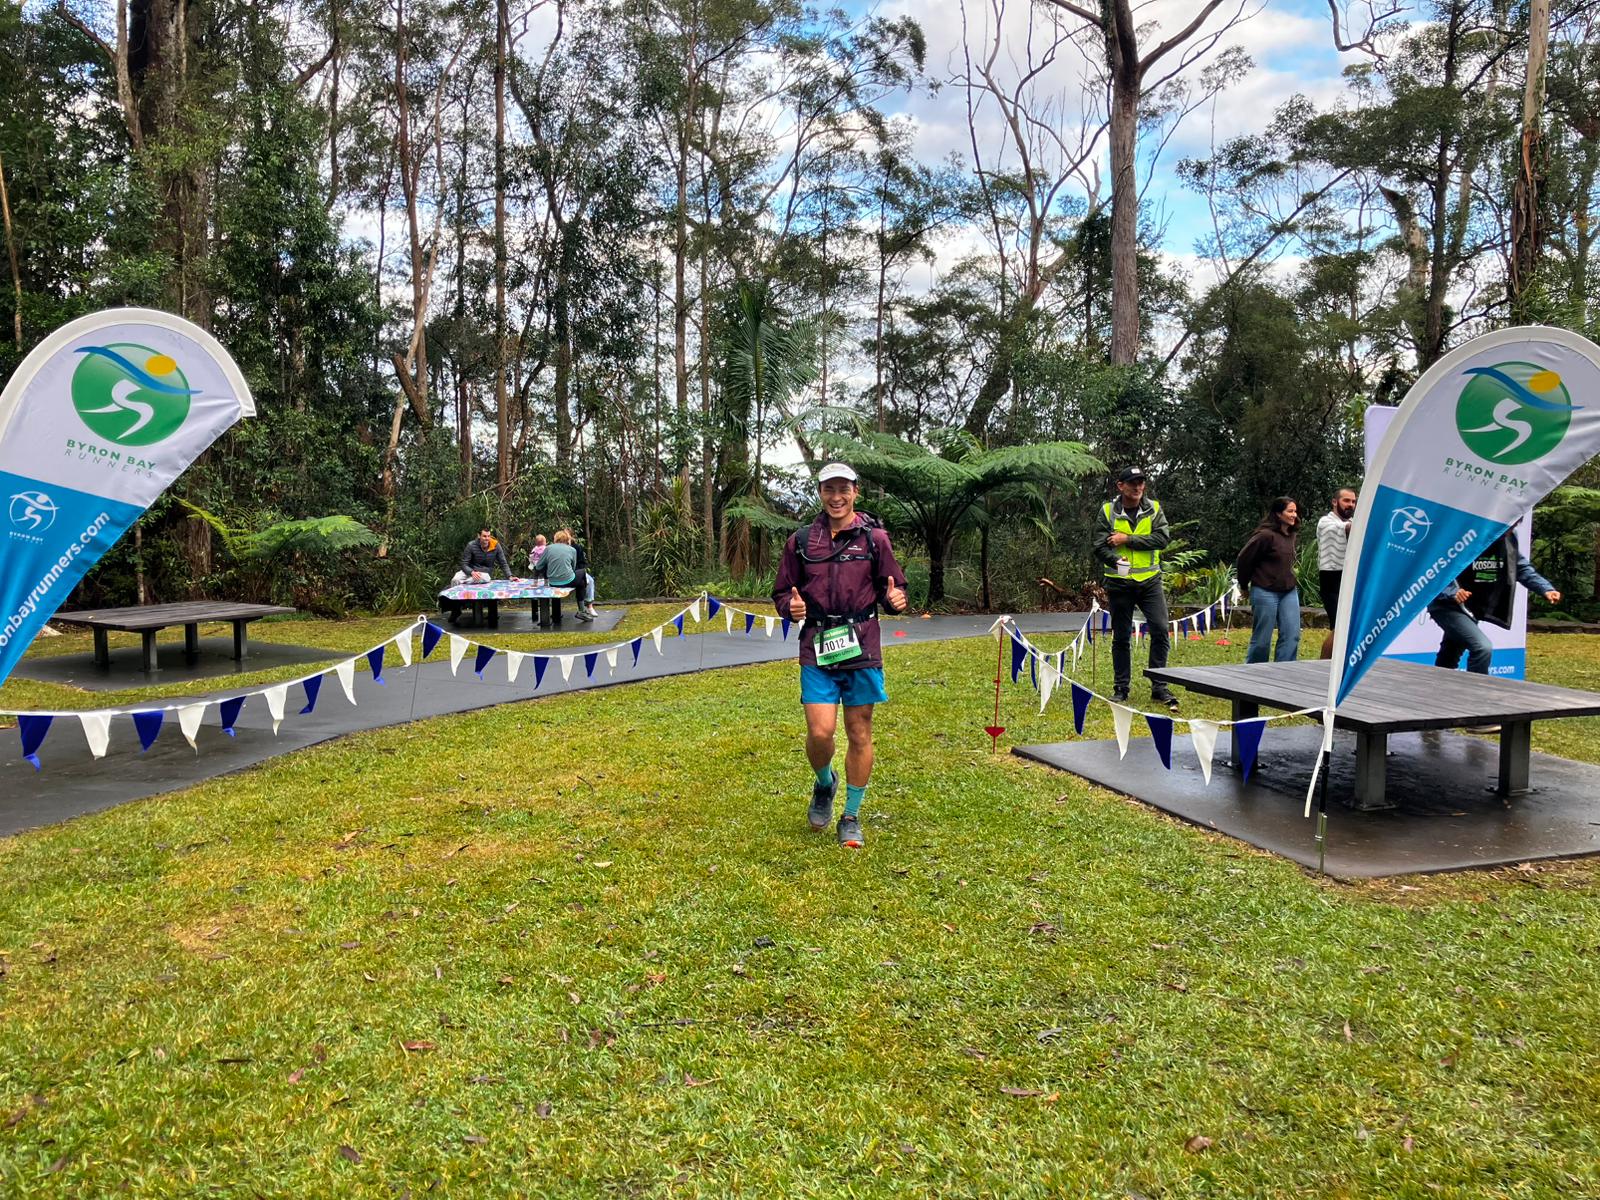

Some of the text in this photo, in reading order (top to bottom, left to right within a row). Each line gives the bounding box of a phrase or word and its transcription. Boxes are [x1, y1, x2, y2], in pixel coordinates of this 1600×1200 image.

[64, 449, 153, 478] RUNNERS
[66, 439, 156, 470] BYRON BAY
[1443, 467, 1526, 497] RUNNERS
[1445, 457, 1528, 489] BYRON BAY
[0, 511, 110, 650] onbayrunners.com
[825, 638, 846, 652] 1012
